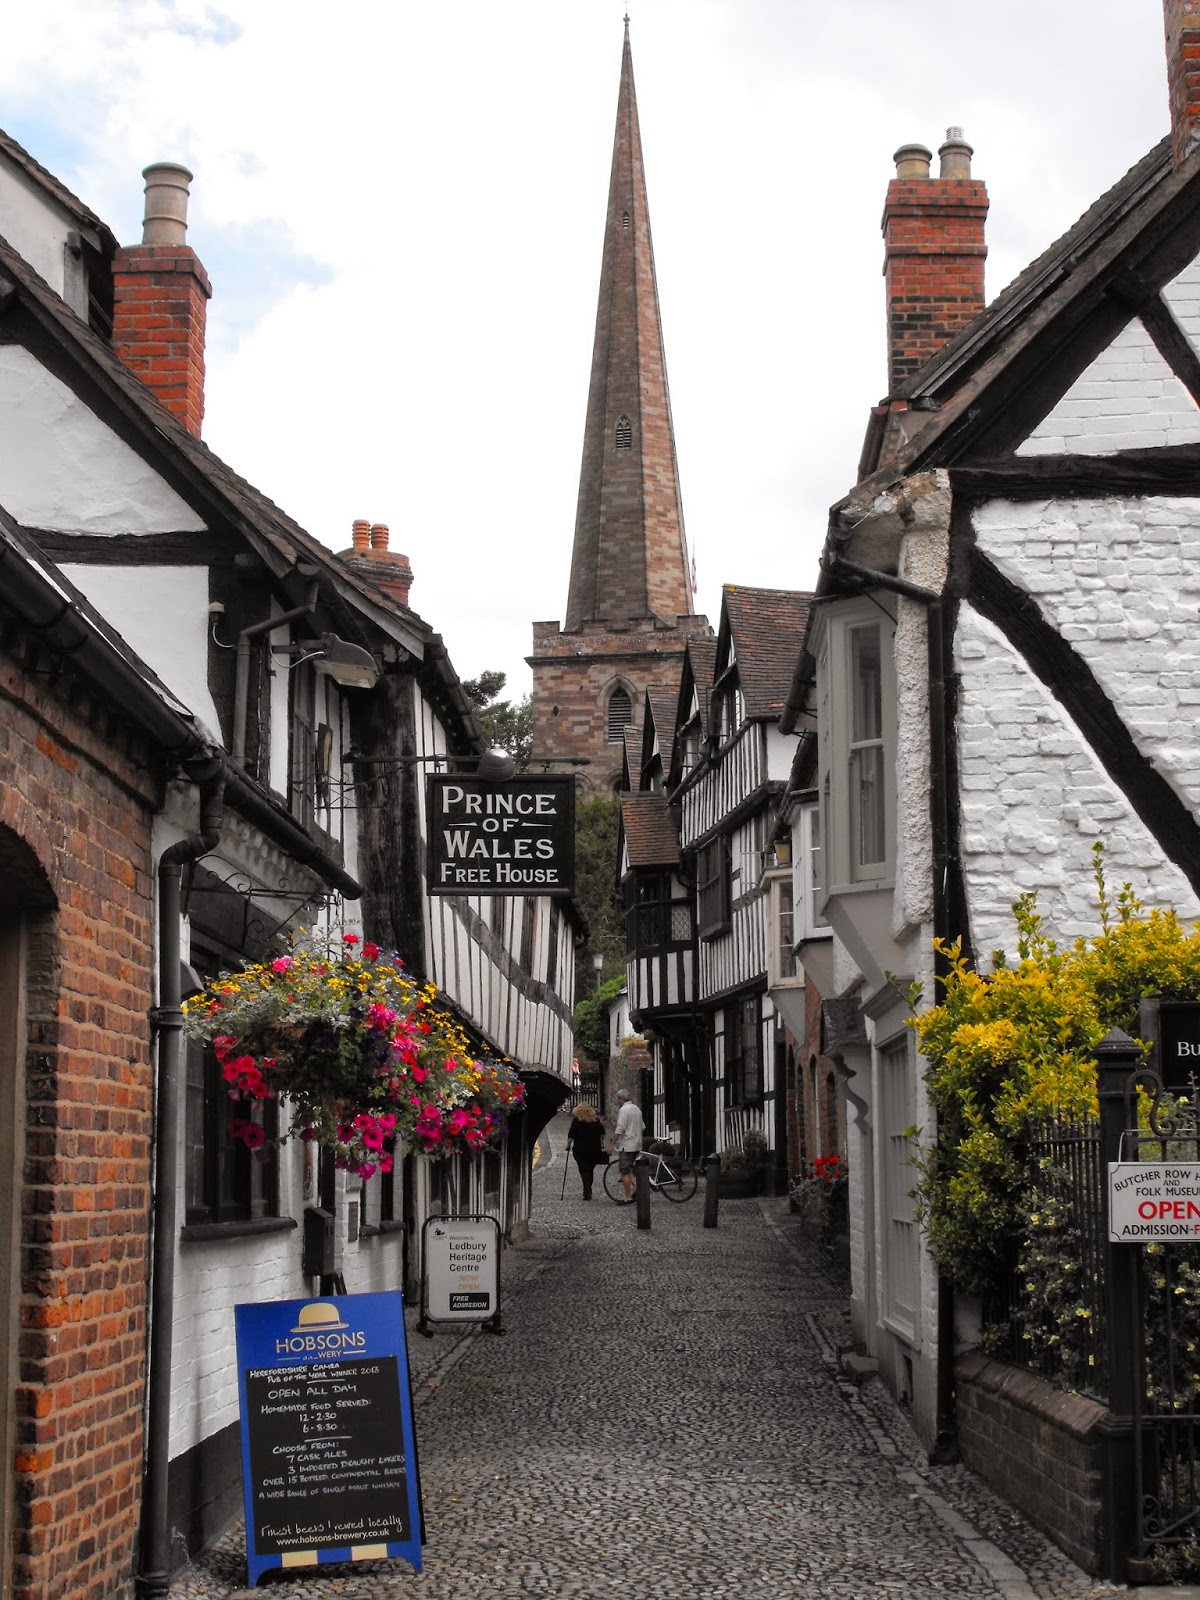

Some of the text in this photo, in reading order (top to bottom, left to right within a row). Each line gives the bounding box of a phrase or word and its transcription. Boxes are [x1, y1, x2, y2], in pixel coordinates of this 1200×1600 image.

[442, 785, 557, 814] PRINCE
[482, 818, 520, 833] OF
[443, 830, 554, 859] WALES
[440, 862, 559, 883] FREE HOUSE
[1114, 1170, 1161, 1192] BUTCHER
[1165, 1170, 1192, 1179] ROW
[1136, 1187, 1161, 1196] FOLK
[1138, 1201, 1200, 1220] OPEN
[449, 1242, 487, 1251] Ledbury
[449, 1253, 487, 1262] Heritage
[449, 1263, 480, 1271] Centre
[276, 1331, 366, 1354] HOBSONS
[249, 1362, 340, 1378] HEREFORDSHIRE CAMRA
[267, 1375, 281, 1383] PUB
[294, 1373, 307, 1381] THE
[308, 1371, 327, 1380] YEAR
[330, 1368, 358, 1378] WINNER
[267, 1384, 357, 1400] OPEN ALL DAY
[261, 1403, 308, 1414] HOMEMADE
[310, 1402, 331, 1411] FOOD
[272, 1444, 307, 1454] CHOOSE
[286, 1450, 348, 1464] 7 CASK ALES
[288, 1454, 406, 1474] 3 IMPORTED DRAUGHT LAGERS
[262, 1476, 285, 1486] OVER
[288, 1475, 299, 1484] 15
[384, 1466, 407, 1476] BEERS
[266, 1490, 285, 1498] WIDE
[287, 1489, 307, 1497] RANGE
[310, 1488, 319, 1496] OF
[322, 1485, 346, 1494] SINGLE
[348, 1483, 369, 1491] MALT
[368, 1515, 403, 1533] locally
[276, 1528, 390, 1546] www.hobsons-brewery.co.uk
